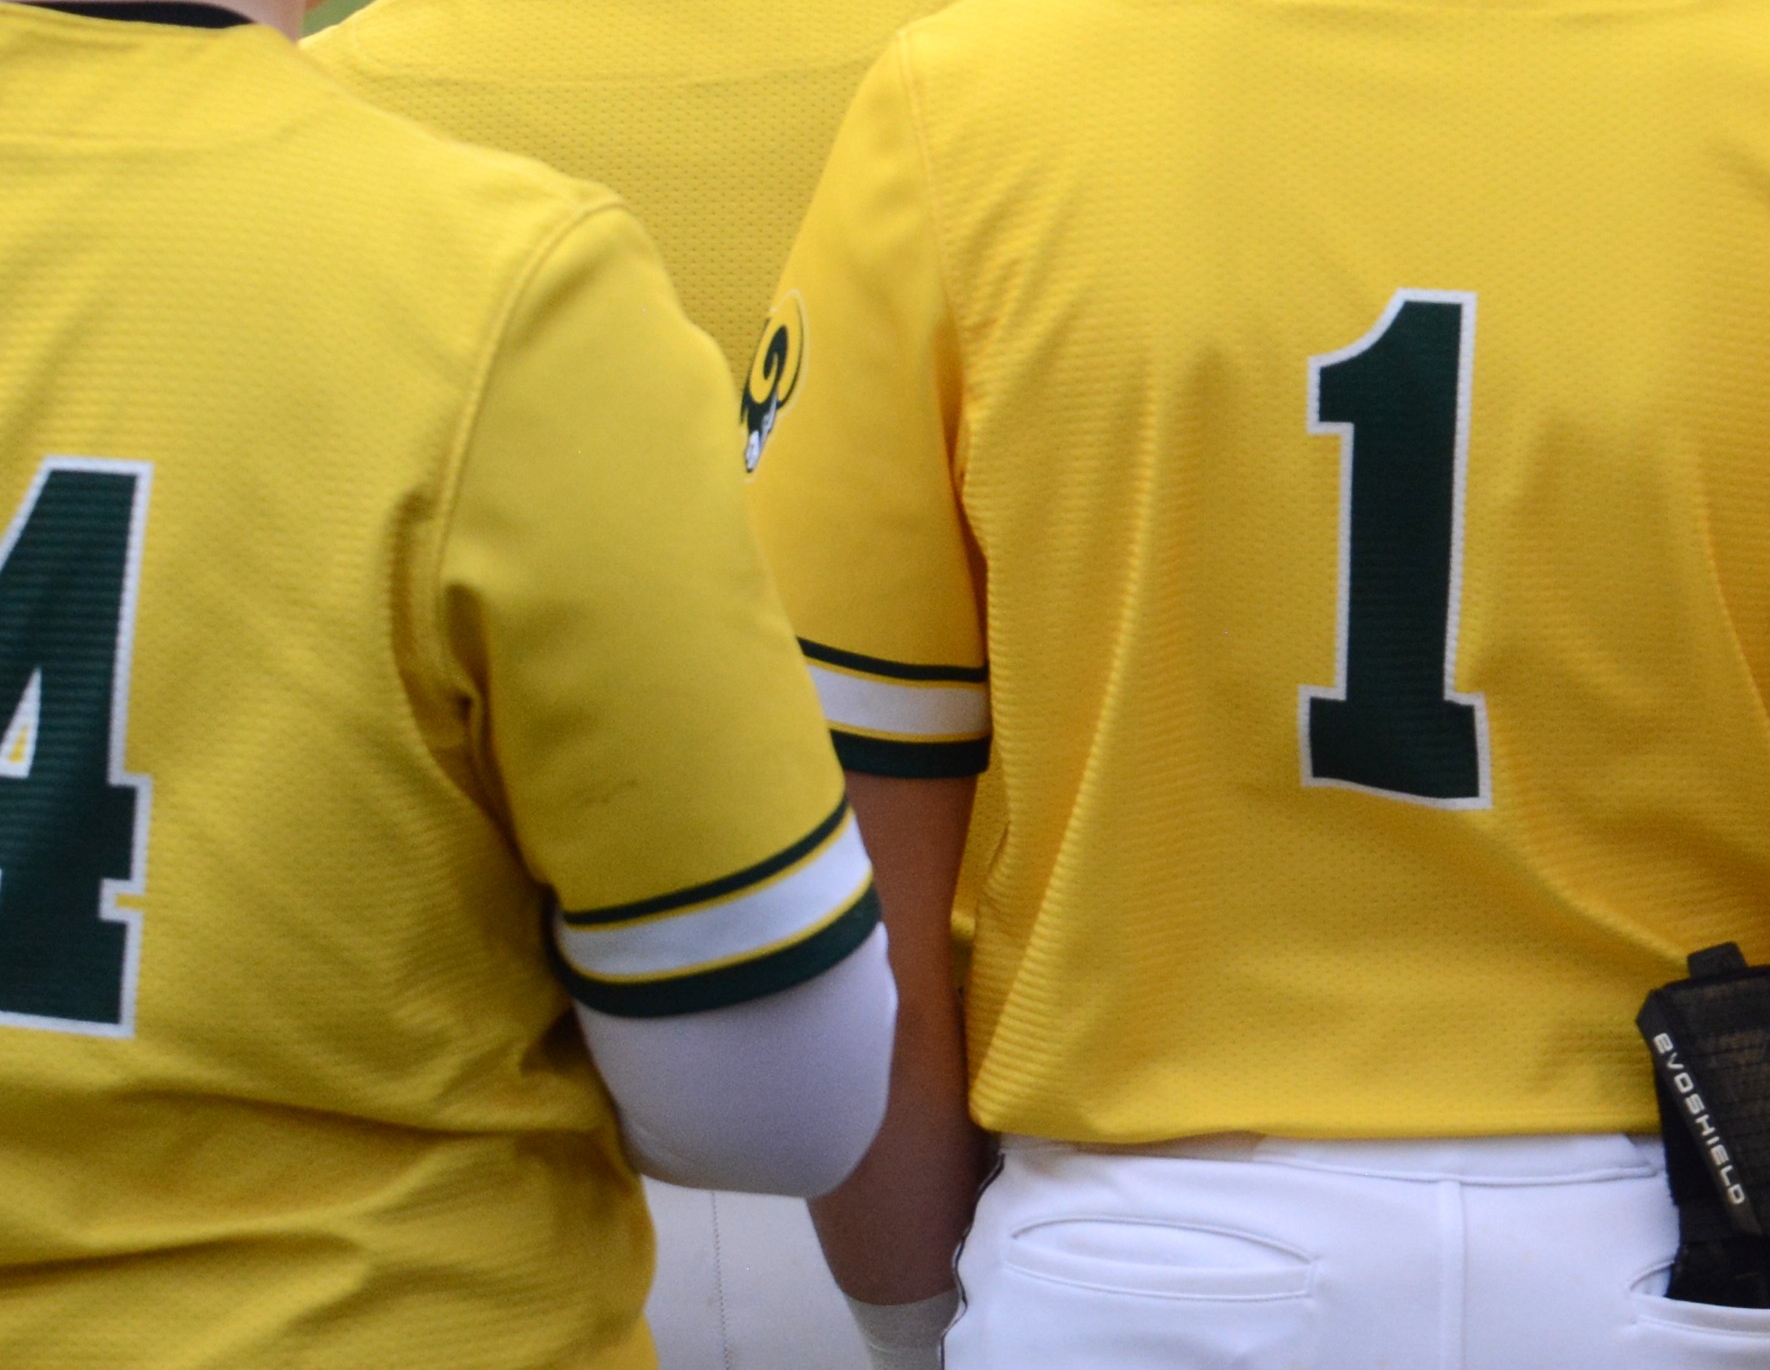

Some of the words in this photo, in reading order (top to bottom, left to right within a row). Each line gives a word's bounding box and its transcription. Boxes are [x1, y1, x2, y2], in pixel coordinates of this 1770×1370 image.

[0, 455, 152, 1038] 4
[1298, 287, 1492, 810] 1
[1652, 1031, 1747, 1207] EVOSHIELD
